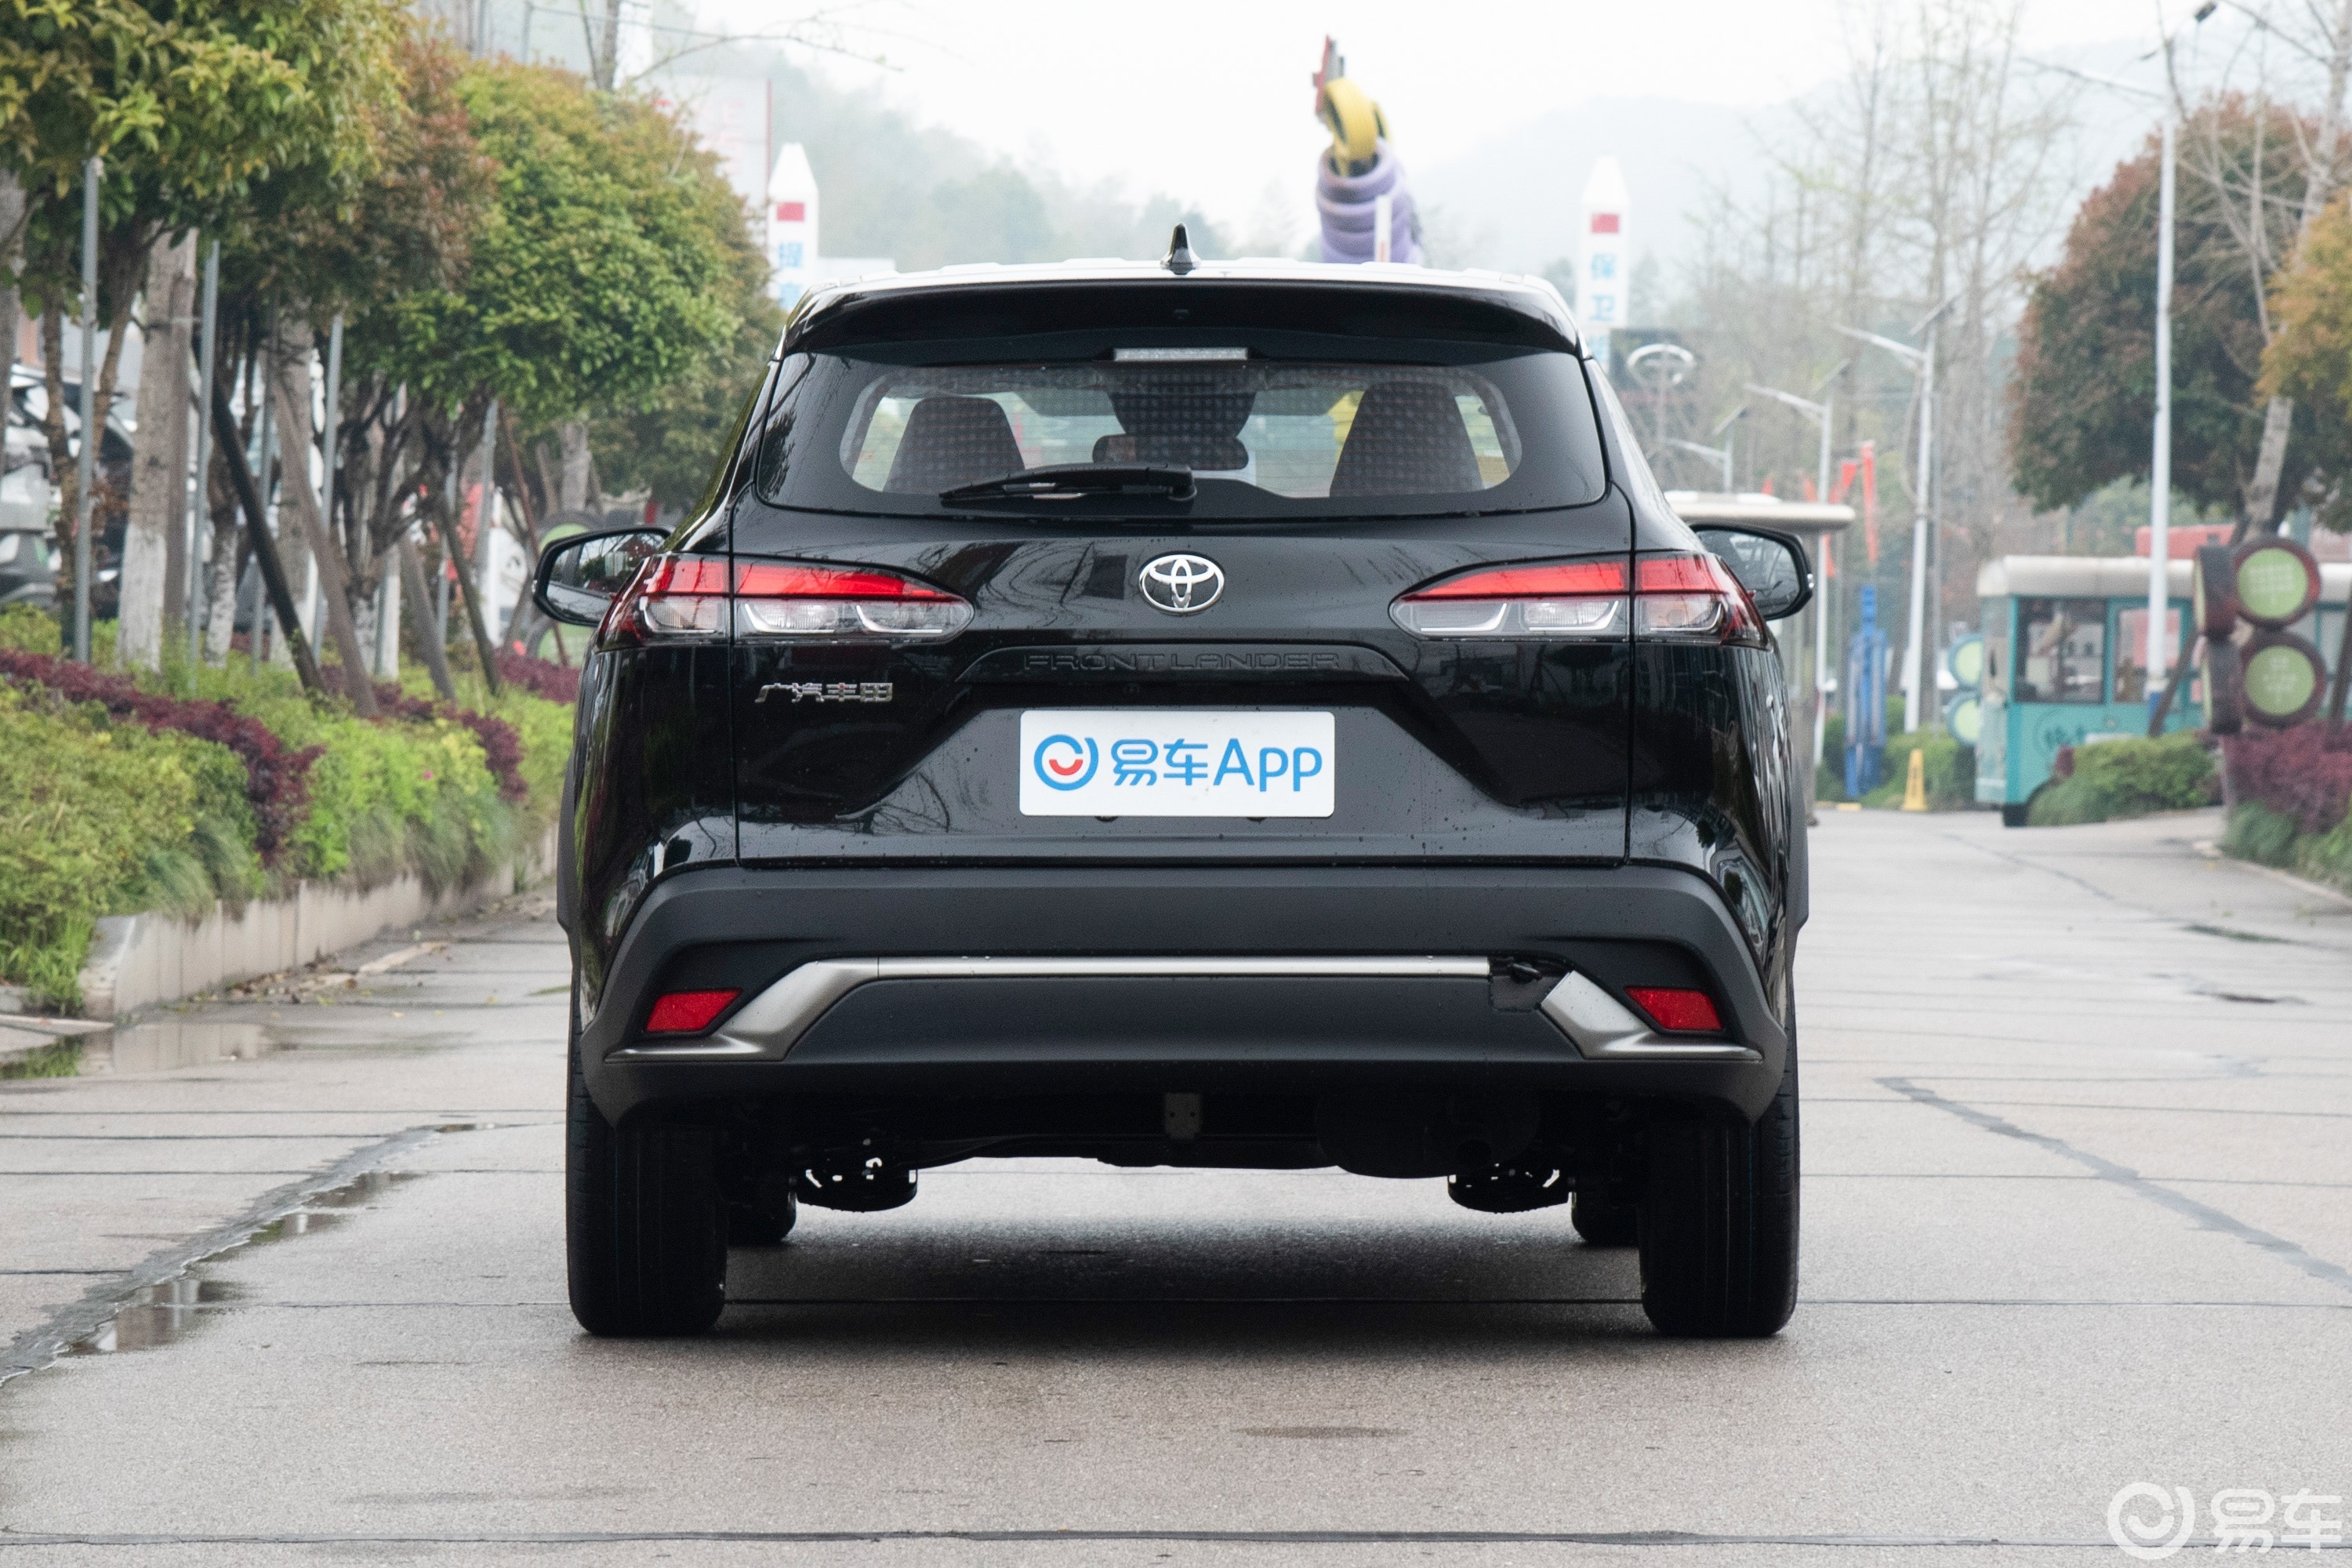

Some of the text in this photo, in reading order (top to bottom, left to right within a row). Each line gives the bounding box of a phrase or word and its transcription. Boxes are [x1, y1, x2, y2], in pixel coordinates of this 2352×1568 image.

[1024, 652, 1340, 670] FRONTLANDER
[754, 682, 894, 703] 广汽丰田
[1110, 737, 1323, 793] 易车App
